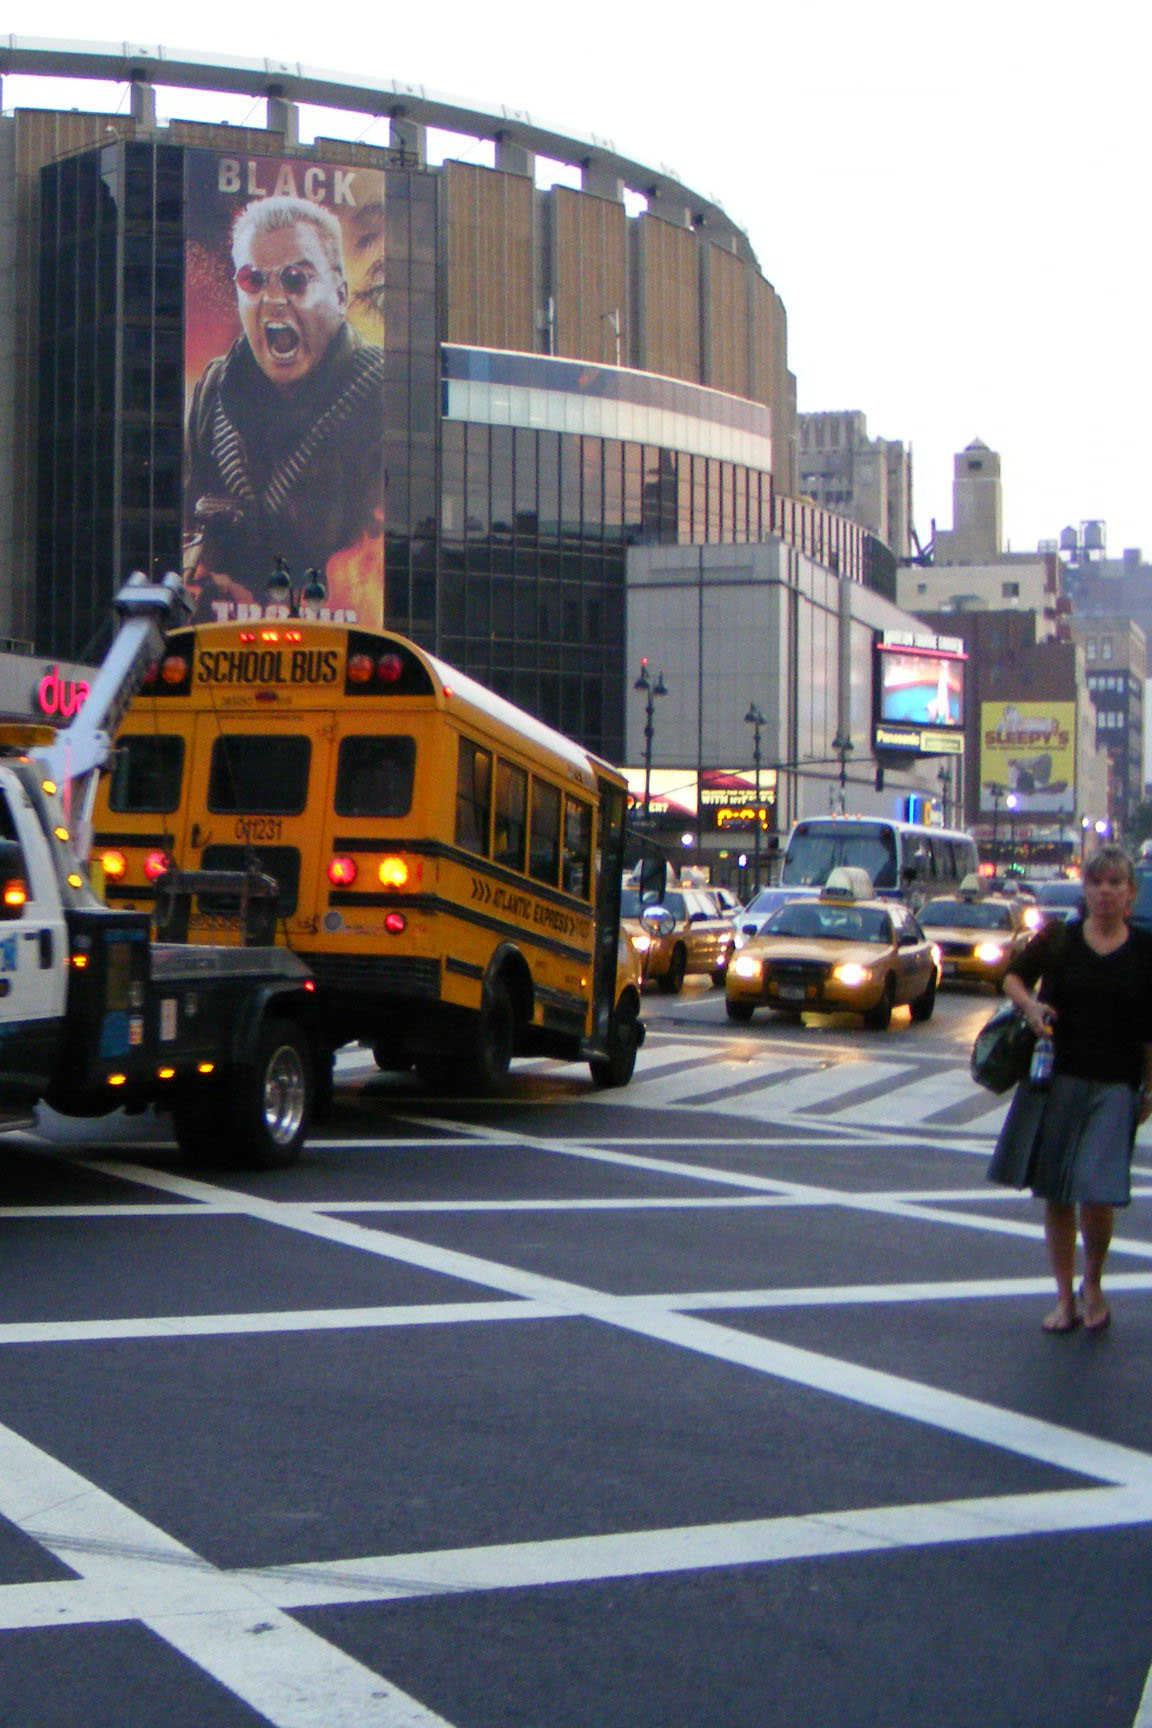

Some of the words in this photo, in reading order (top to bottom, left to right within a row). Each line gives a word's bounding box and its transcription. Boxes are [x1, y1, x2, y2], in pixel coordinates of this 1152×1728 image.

[217, 158, 357, 207] BLACK
[198, 650, 287, 683] SCHOOL
[290, 650, 338, 683] BUS
[493, 887, 532, 921] ATLANTIC
[533, 903, 569, 934] EXPRESS
